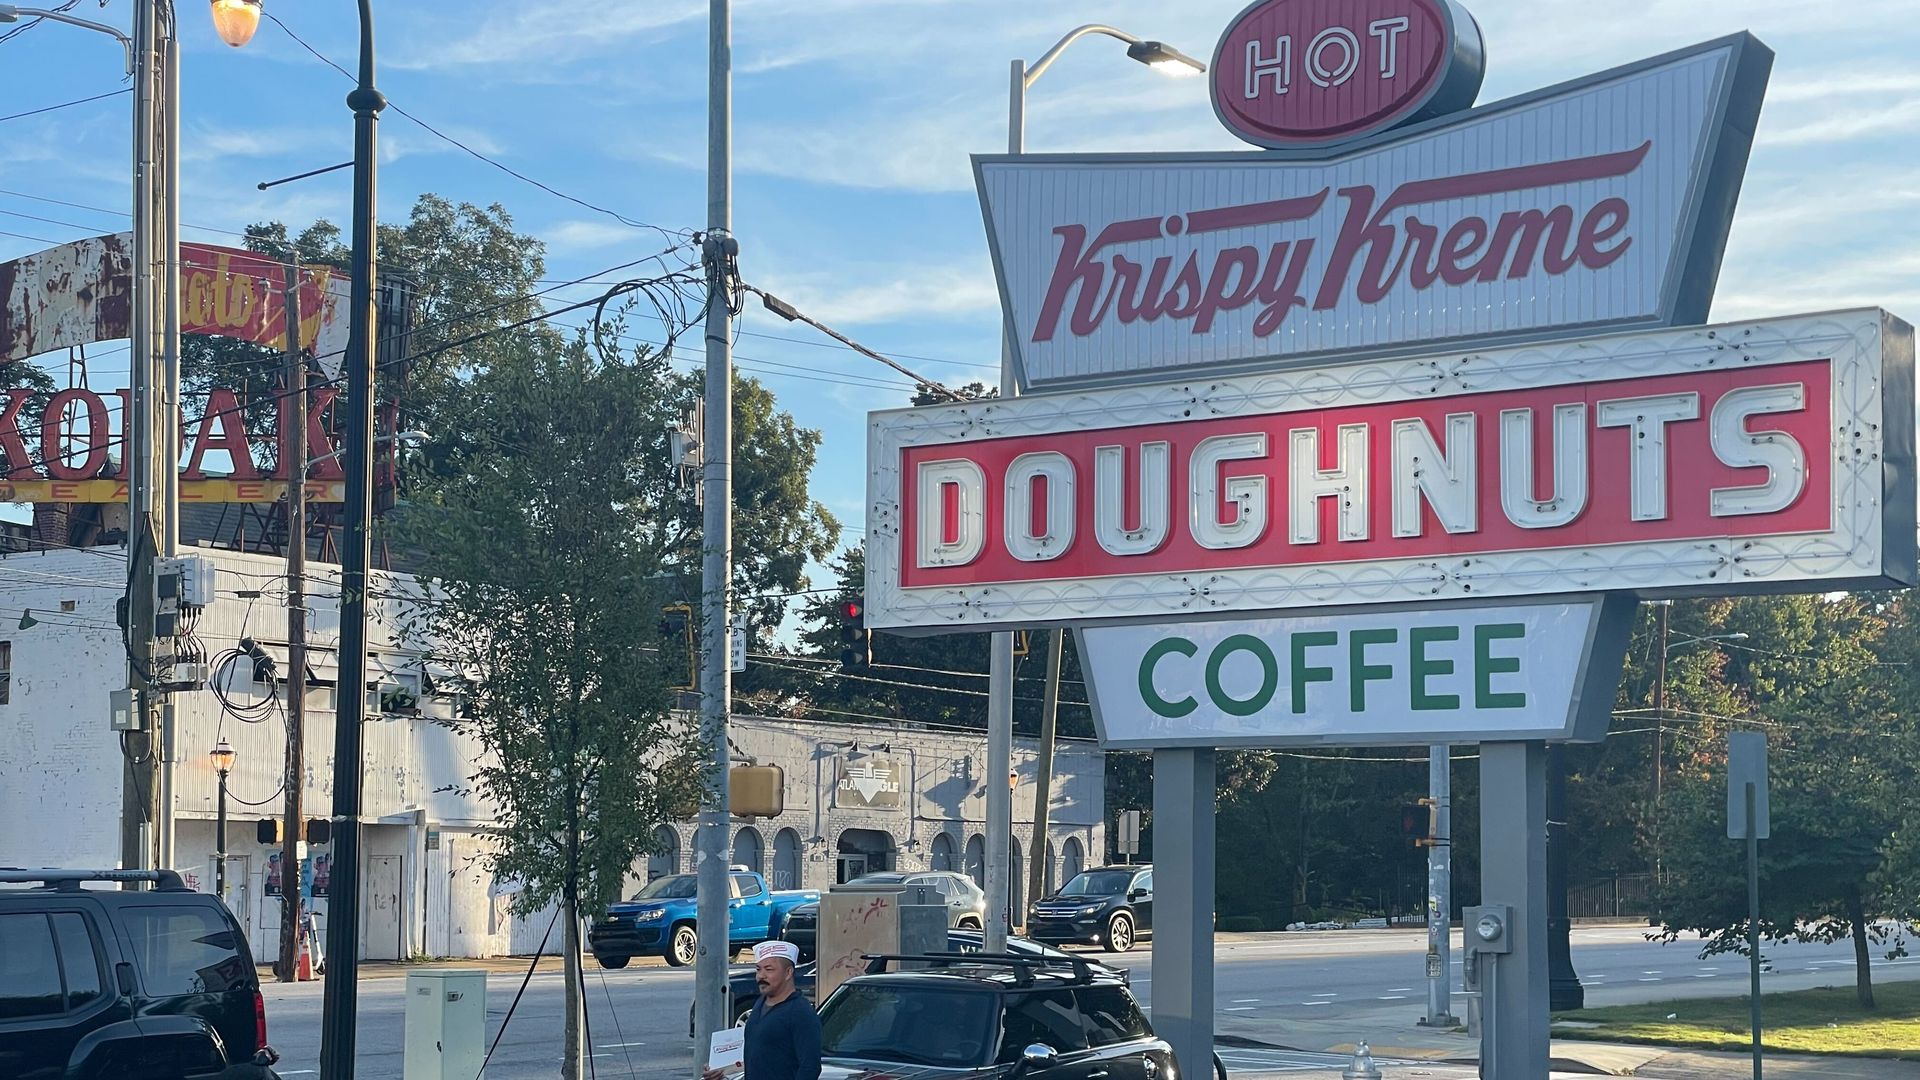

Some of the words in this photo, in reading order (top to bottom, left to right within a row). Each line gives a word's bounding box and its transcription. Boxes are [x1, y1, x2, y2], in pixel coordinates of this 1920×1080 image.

[1244, 16, 1410, 100] HOT
[1031, 186, 1330, 340] Krispy
[1312, 139, 1652, 312] Kreme
[0, 387, 346, 481] KOAK
[915, 381, 1807, 570] DOUGHNUTS
[1137, 622, 1527, 720] COFFEE
[880, 781, 899, 793] GLE
